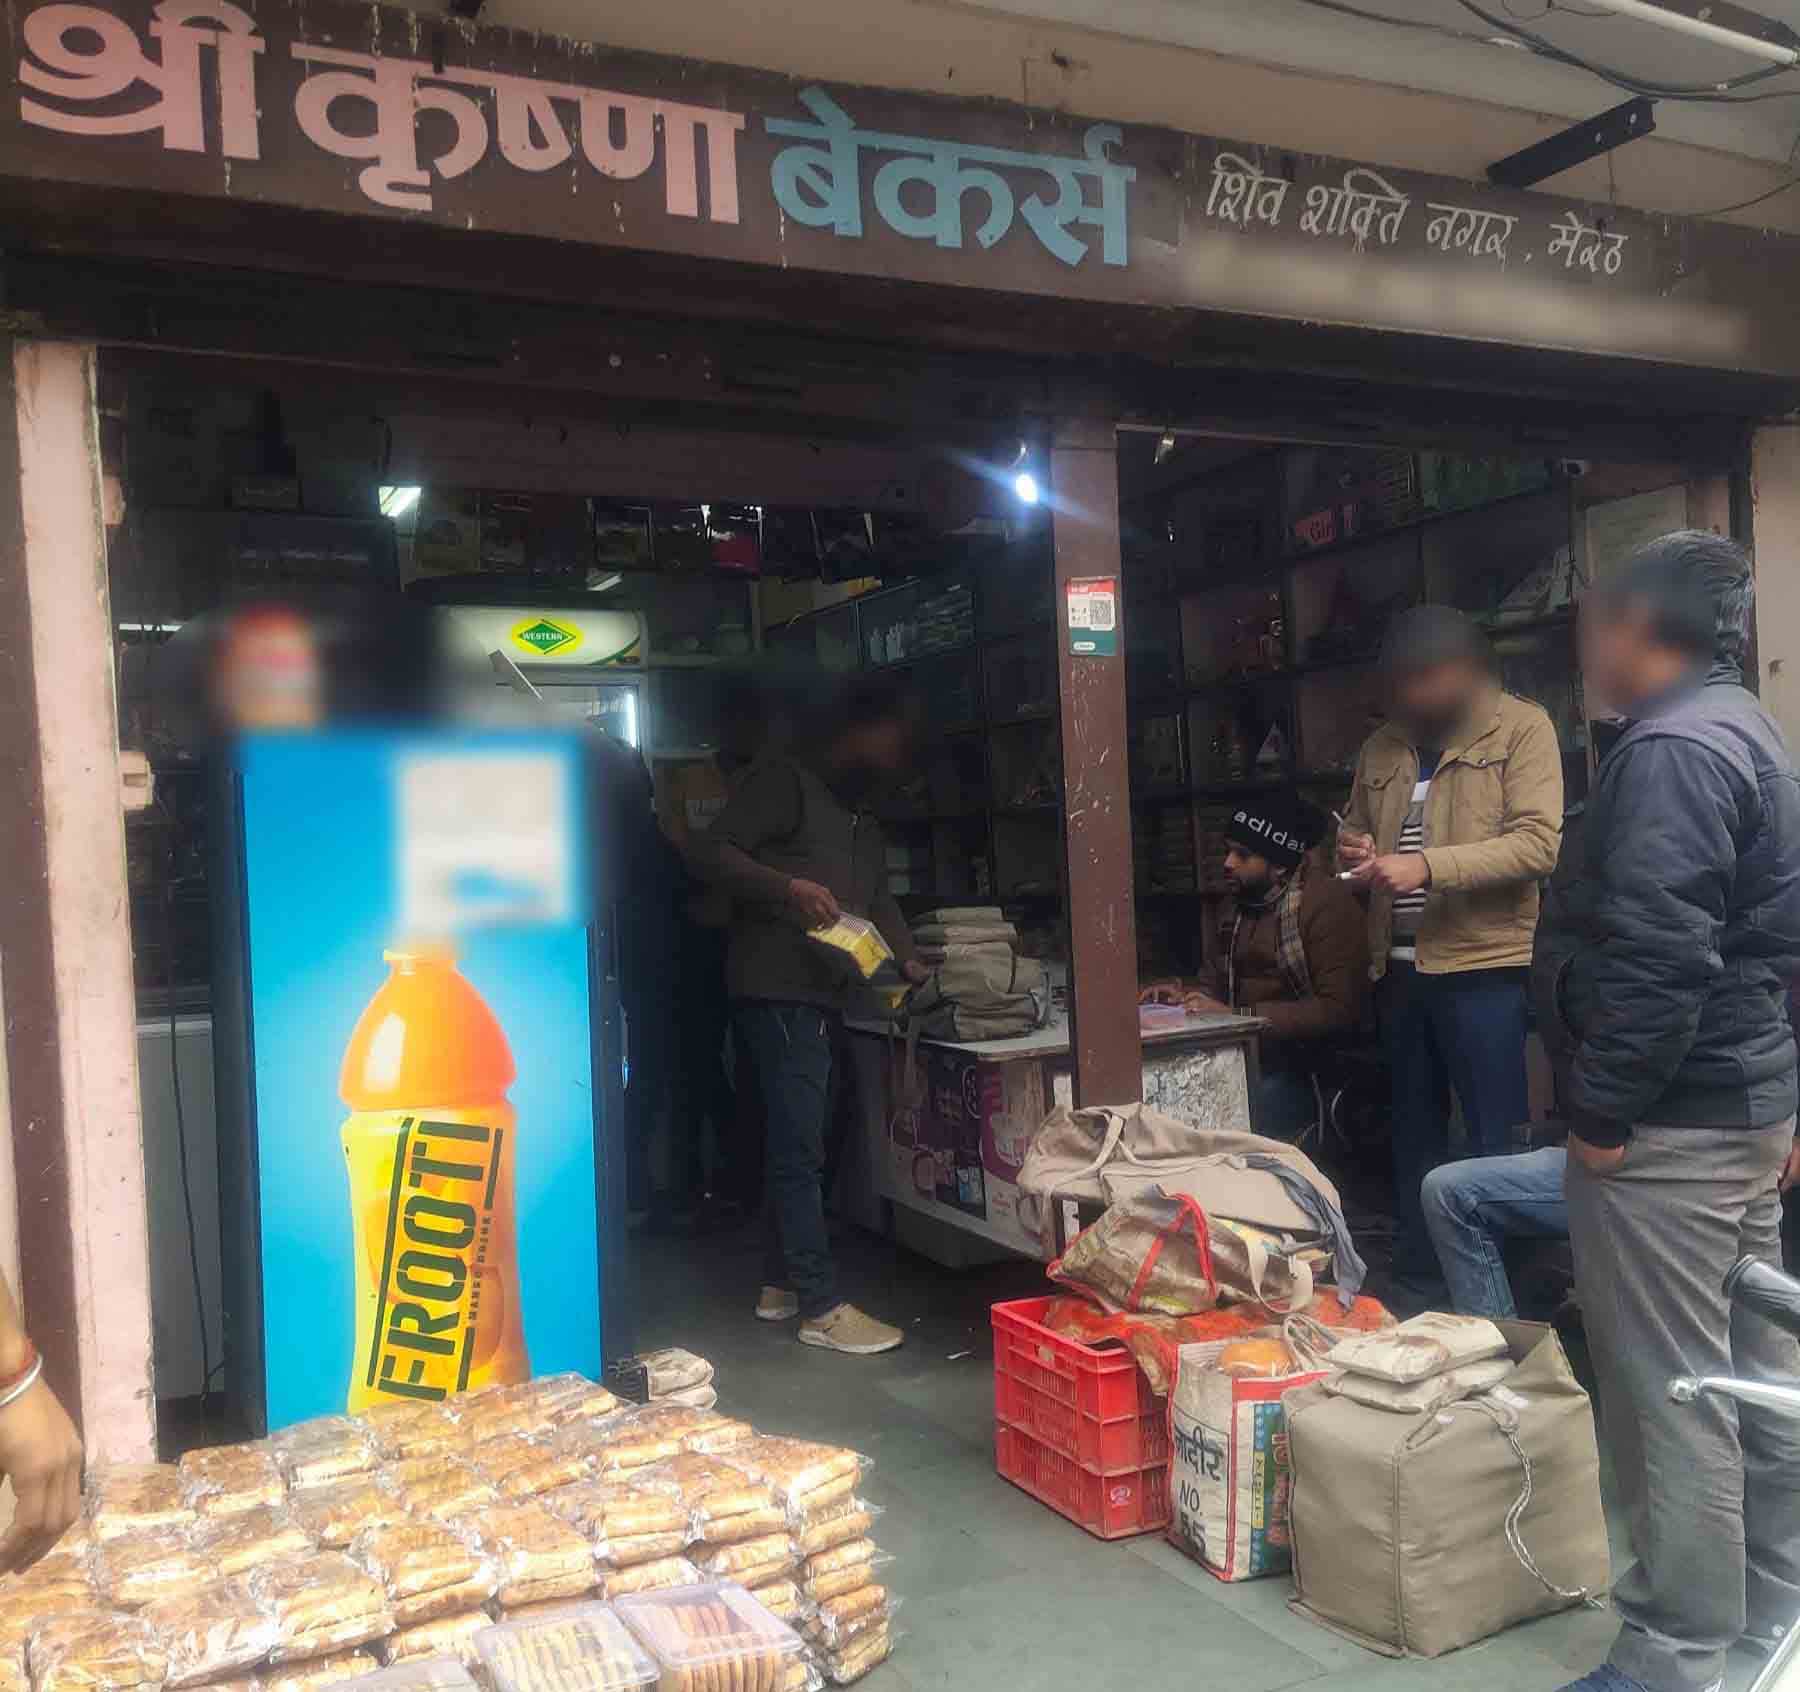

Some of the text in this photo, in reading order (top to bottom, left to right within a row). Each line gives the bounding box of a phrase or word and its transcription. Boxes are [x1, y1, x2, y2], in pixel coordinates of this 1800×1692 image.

[19, 0, 1137, 266] श्री कृष्णा बेकर्स
[1205, 152, 1294, 226] शिव
[1300, 167, 1411, 246] शक्ति
[1547, 211, 1630, 275] मेरठ
[523, 631, 563, 641] WESTERN
[377, 1120, 491, 1402] FROOTI
